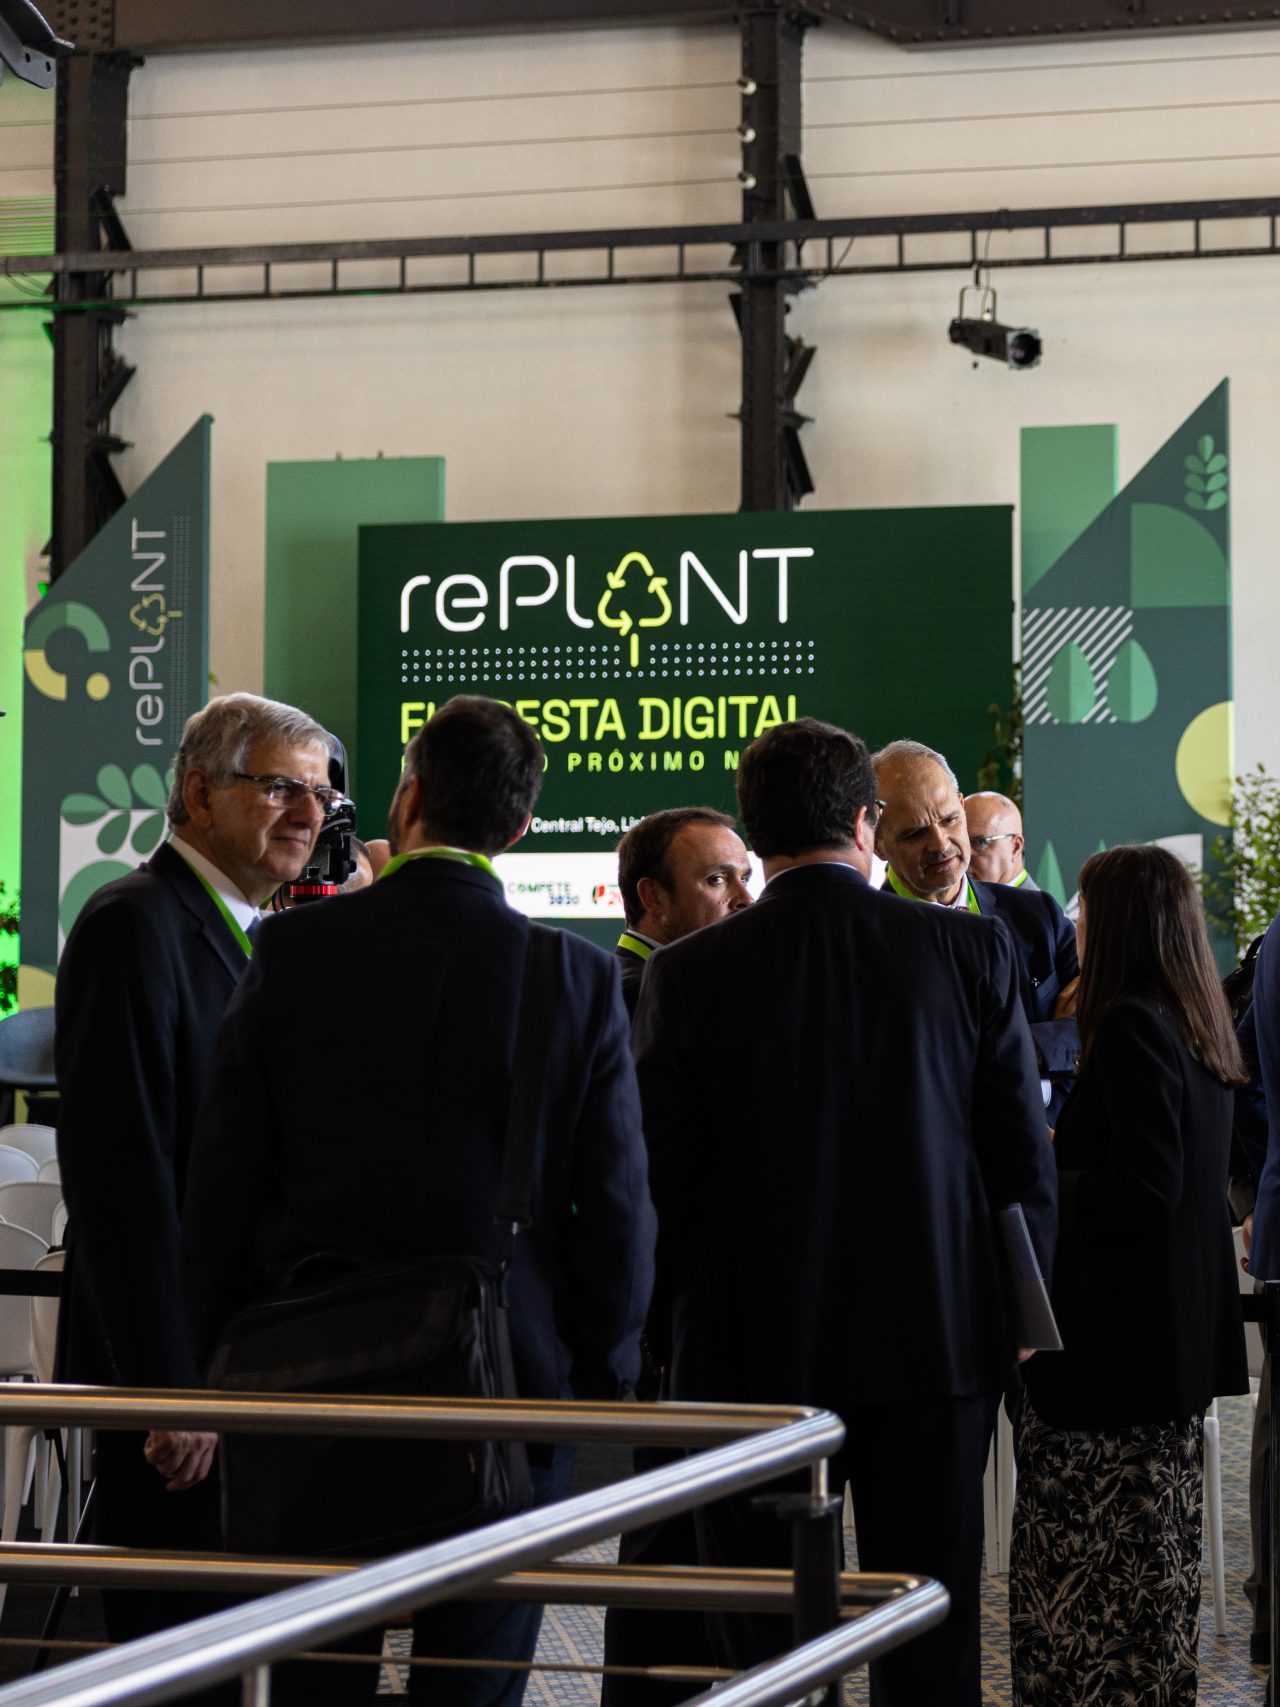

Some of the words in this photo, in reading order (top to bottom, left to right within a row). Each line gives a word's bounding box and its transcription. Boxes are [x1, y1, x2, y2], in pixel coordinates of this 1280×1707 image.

[400, 546, 815, 667] rePLANT
[401, 698, 626, 744] FESTA
[567, 748, 705, 773] PRÓXIMO
[531, 816, 584, 833] Central
